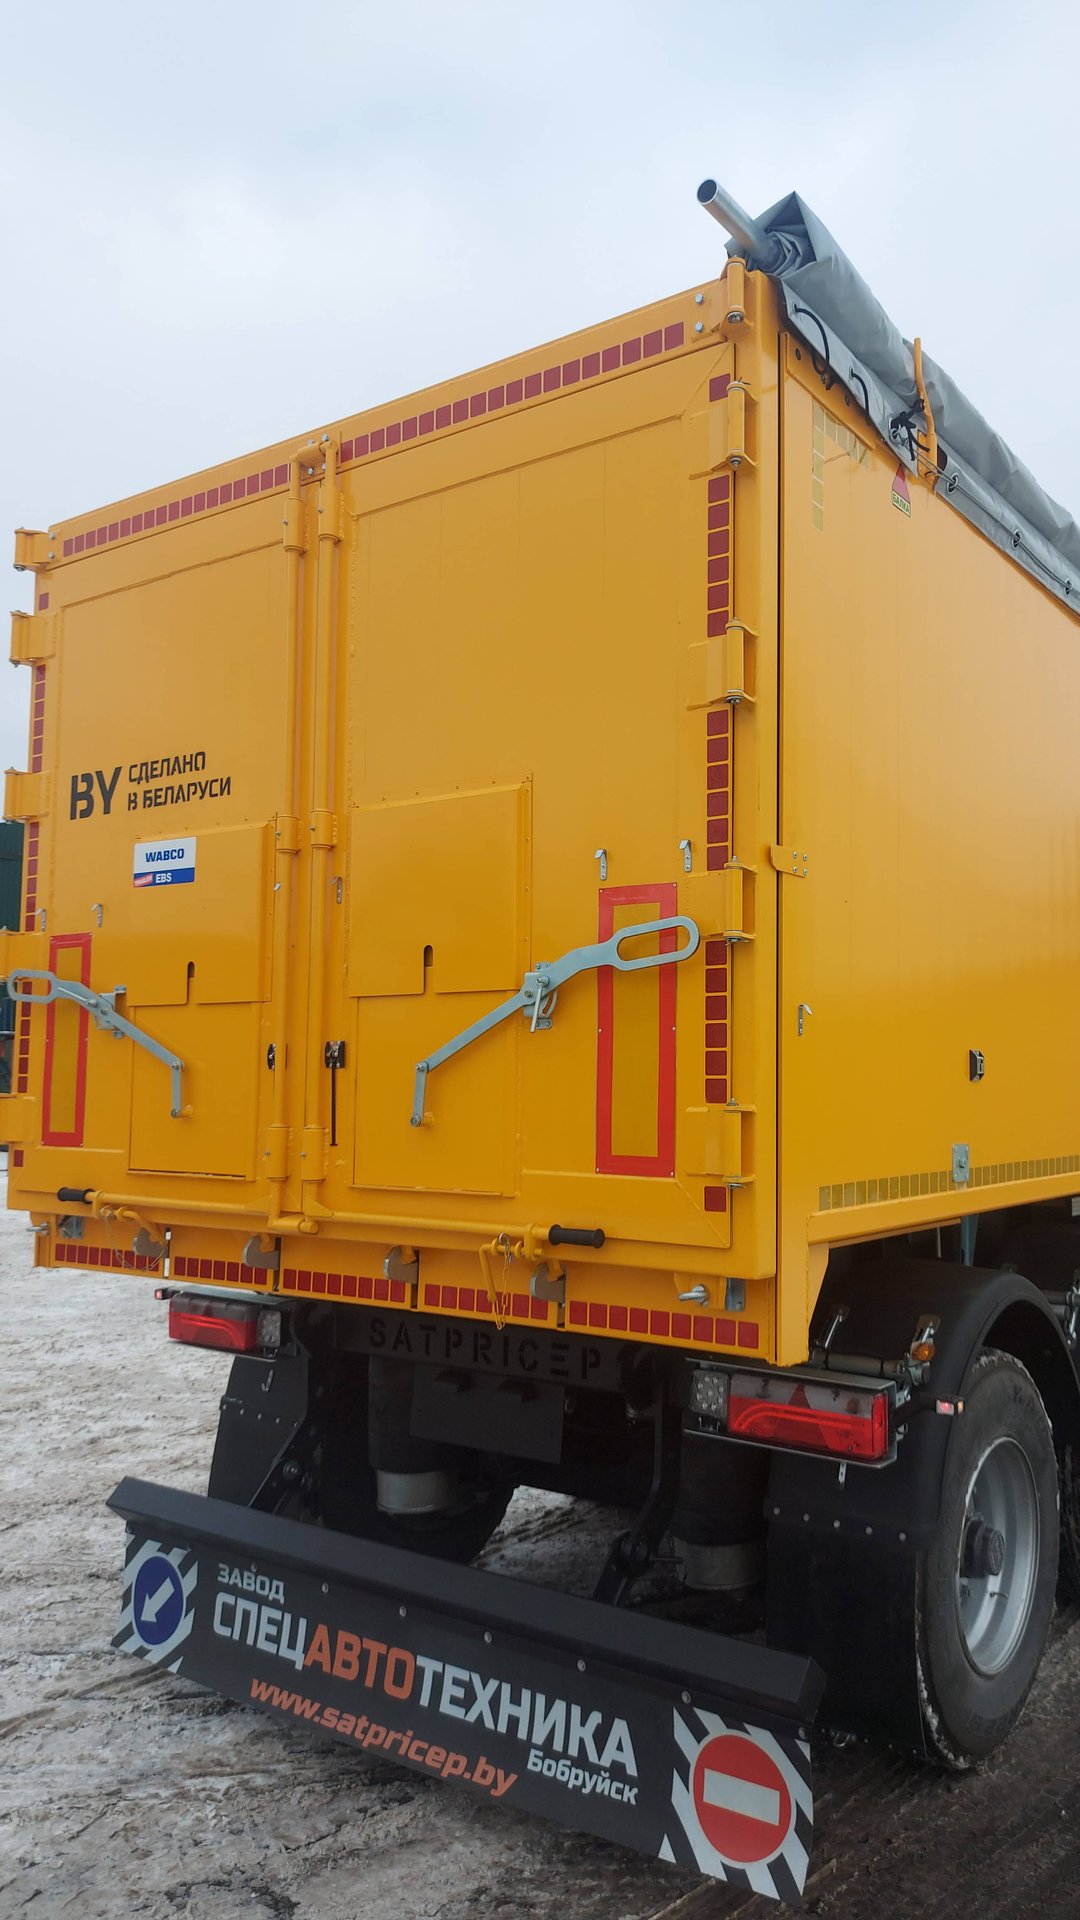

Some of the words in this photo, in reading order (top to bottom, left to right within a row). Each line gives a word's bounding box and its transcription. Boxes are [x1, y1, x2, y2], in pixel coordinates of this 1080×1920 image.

[128, 751, 206, 785] СДЕЛАНО
[69, 766, 123, 820] BY
[127, 792, 138, 811] В
[142, 776, 232, 809] БЕЛАРУСИ
[145, 848, 184, 863] WABCO
[155, 873, 172, 884] EBS
[368, 1317, 601, 1380] SATPRICEP
[217, 1563, 285, 1604] ЗАВОД
[213, 1591, 639, 1777] СПЕЦАВТОТЕХНИКА
[250, 1678, 518, 1797] www.satpricep.by
[526, 1748, 639, 1805] Бобруйск
